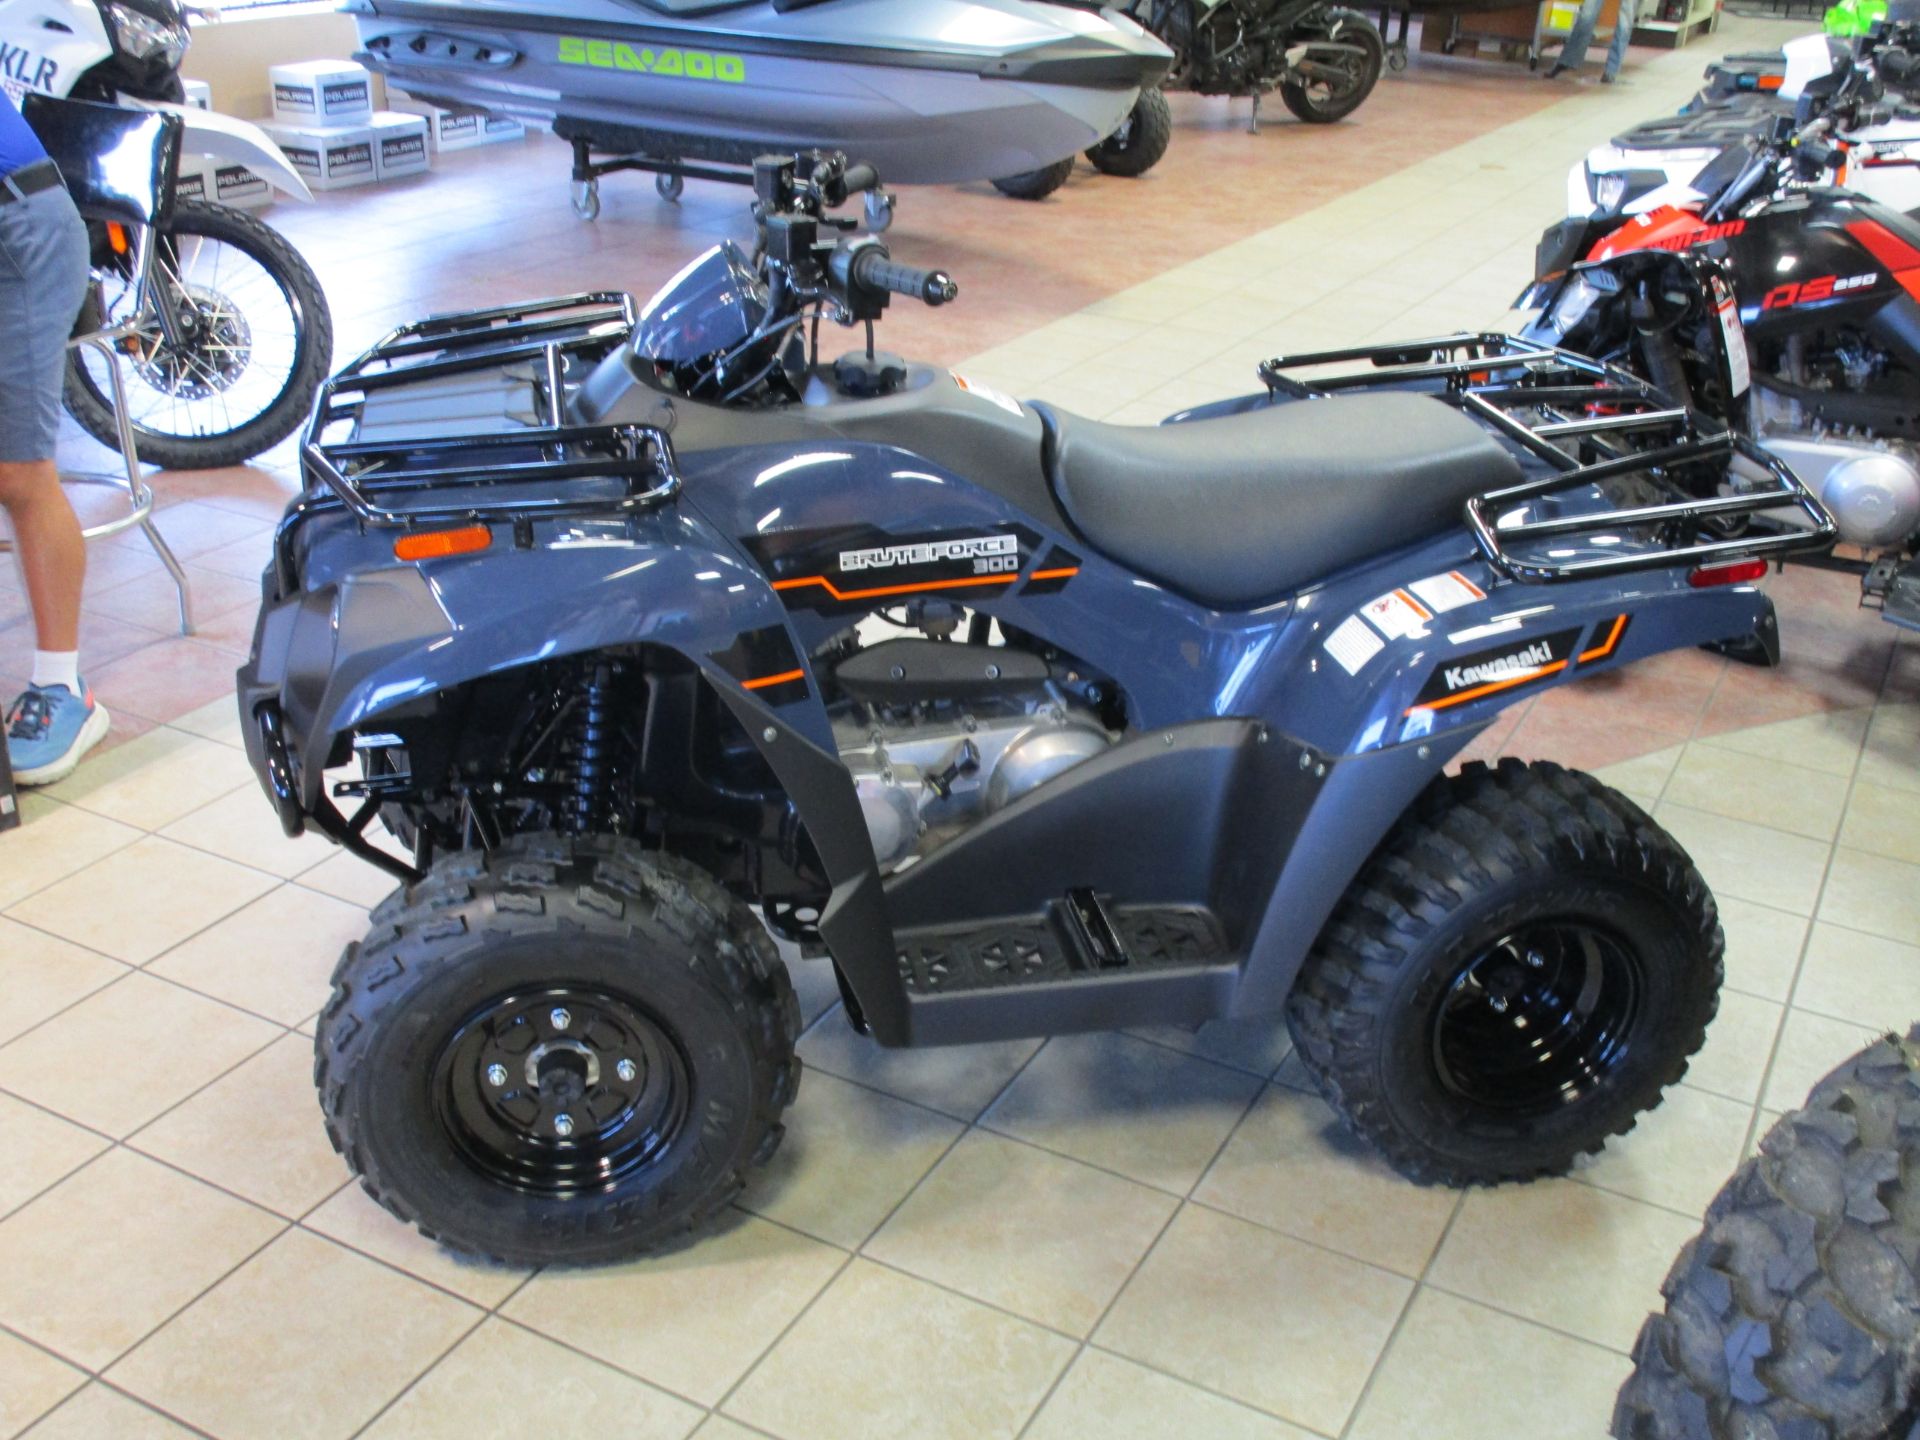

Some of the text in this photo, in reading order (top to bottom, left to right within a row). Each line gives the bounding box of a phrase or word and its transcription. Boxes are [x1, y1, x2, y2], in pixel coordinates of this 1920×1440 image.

[0, 42, 59, 93] KLR
[973, 555, 1018, 574] 300
[1444, 640, 1553, 690] Kawasaki
